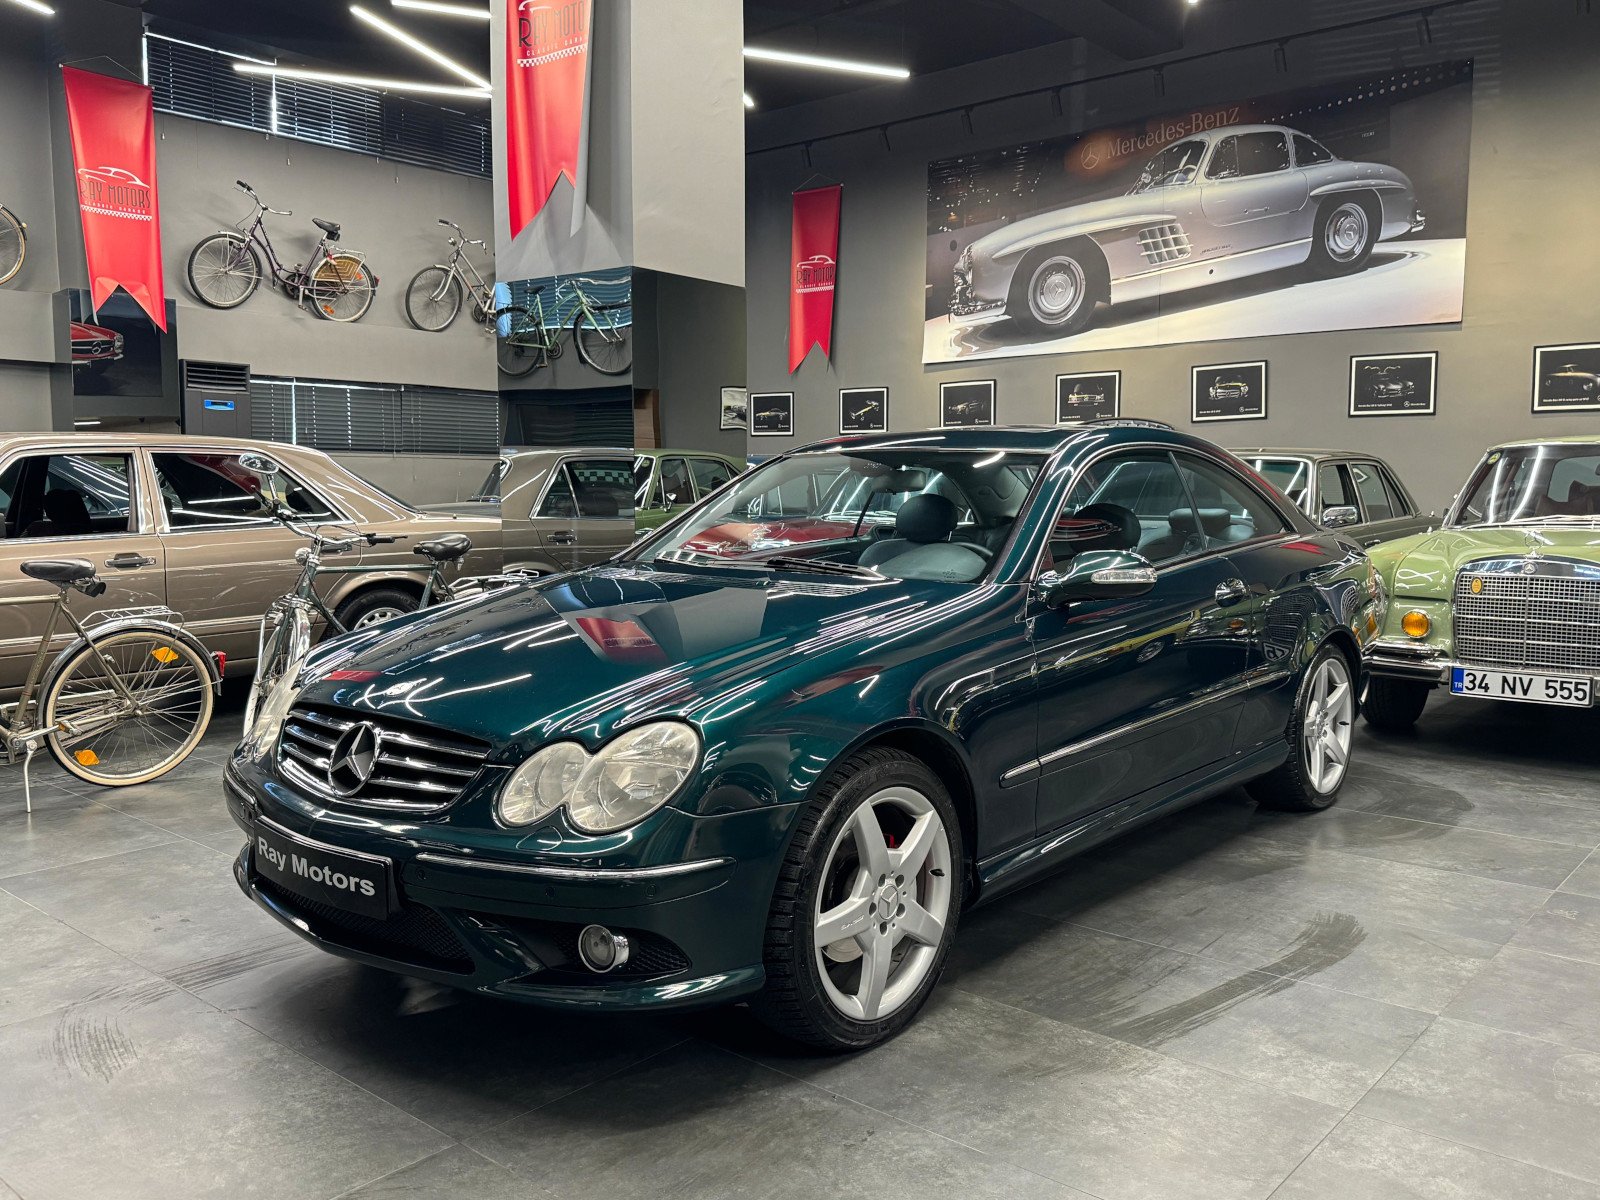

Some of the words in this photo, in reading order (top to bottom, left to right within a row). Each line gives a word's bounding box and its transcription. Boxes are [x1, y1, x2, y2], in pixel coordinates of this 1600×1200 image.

[518, 11, 548, 47] RAY
[553, 2, 585, 40] MOTO
[1107, 106, 1240, 159] Mercedes-Benz
[80, 179, 102, 202] RAY
[108, 184, 151, 208] MOTORS
[1454, 681, 1463, 689] TR
[1464, 672, 1490, 693] 34
[1501, 675, 1533, 696] NV
[1544, 678, 1588, 702] 555
[258, 836, 287, 872] Ray
[291, 853, 376, 896] Motors
